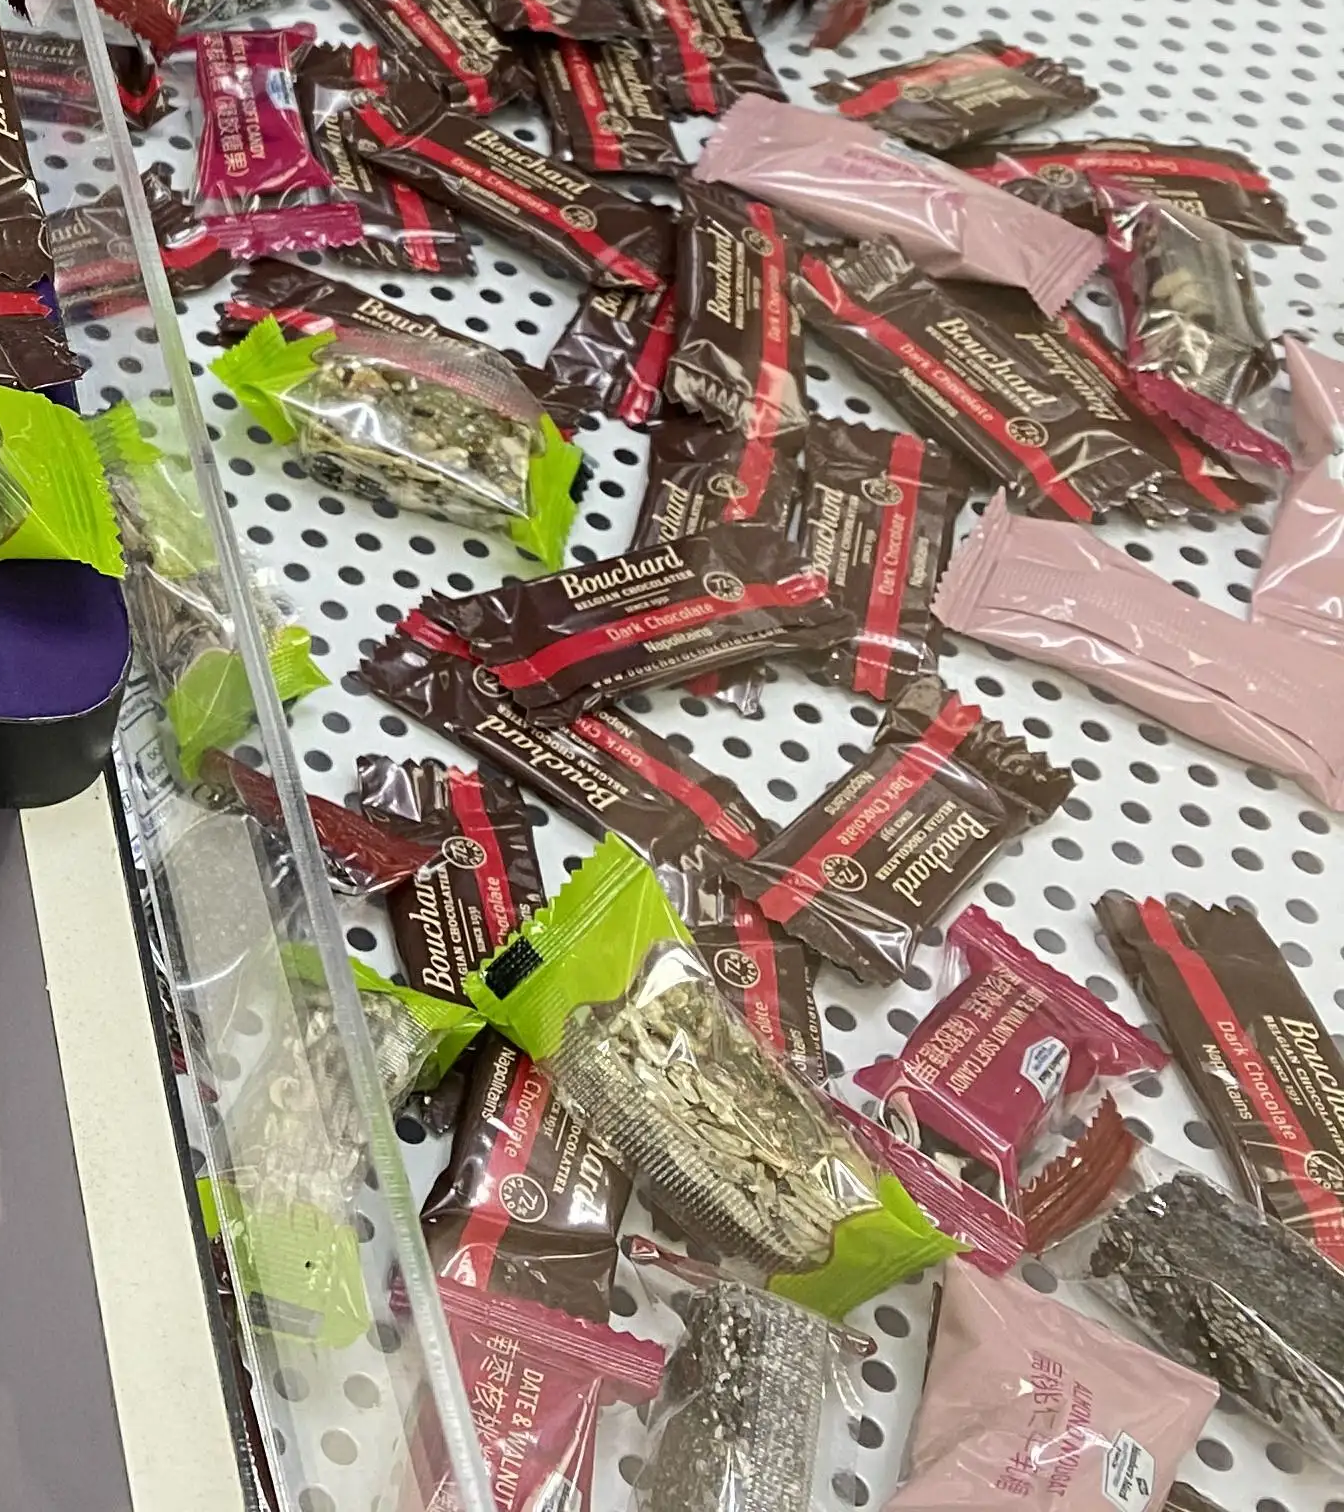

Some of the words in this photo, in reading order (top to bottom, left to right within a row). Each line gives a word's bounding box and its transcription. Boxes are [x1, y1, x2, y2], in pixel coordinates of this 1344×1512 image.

[6, 38, 75, 57] chard
[472, 129, 591, 195] Bouchard
[899, 343, 932, 371] Dark
[931, 368, 995, 423] Chocolate
[936, 317, 1058, 407] Bouchard
[560, 544, 685, 601] Bouchard
[574, 591, 622, 612] BELGIAN
[624, 568, 696, 597] CHOCOLATIER
[606, 621, 645, 642] Dark
[645, 602, 715, 632] Chocolate
[475, 713, 622, 813] Bouchard
[577, 758, 631, 796] BELGIAN
[604, 738, 644, 768] Dark
[883, 774, 914, 801] Dark
[835, 797, 891, 847] Chocolate
[891, 811, 991, 908] Bouchard
[975, 1033, 1001, 1068] SOFT
[1262, 1014, 1301, 1065] BELGIAN
[481, 1046, 518, 1121] Napolitains
[945, 1053, 983, 1097] CANDY
[1201, 1044, 1253, 1121] Naptains
[1217, 1020, 1249, 1057] Dark
[1243, 1061, 1297, 1141] Chocolate
[503, 1079, 542, 1158] Chocolate
[515, 1367, 545, 1415] DATE
[511, 1412, 533, 1429] &
[494, 1430, 529, 1511] WALNUT
